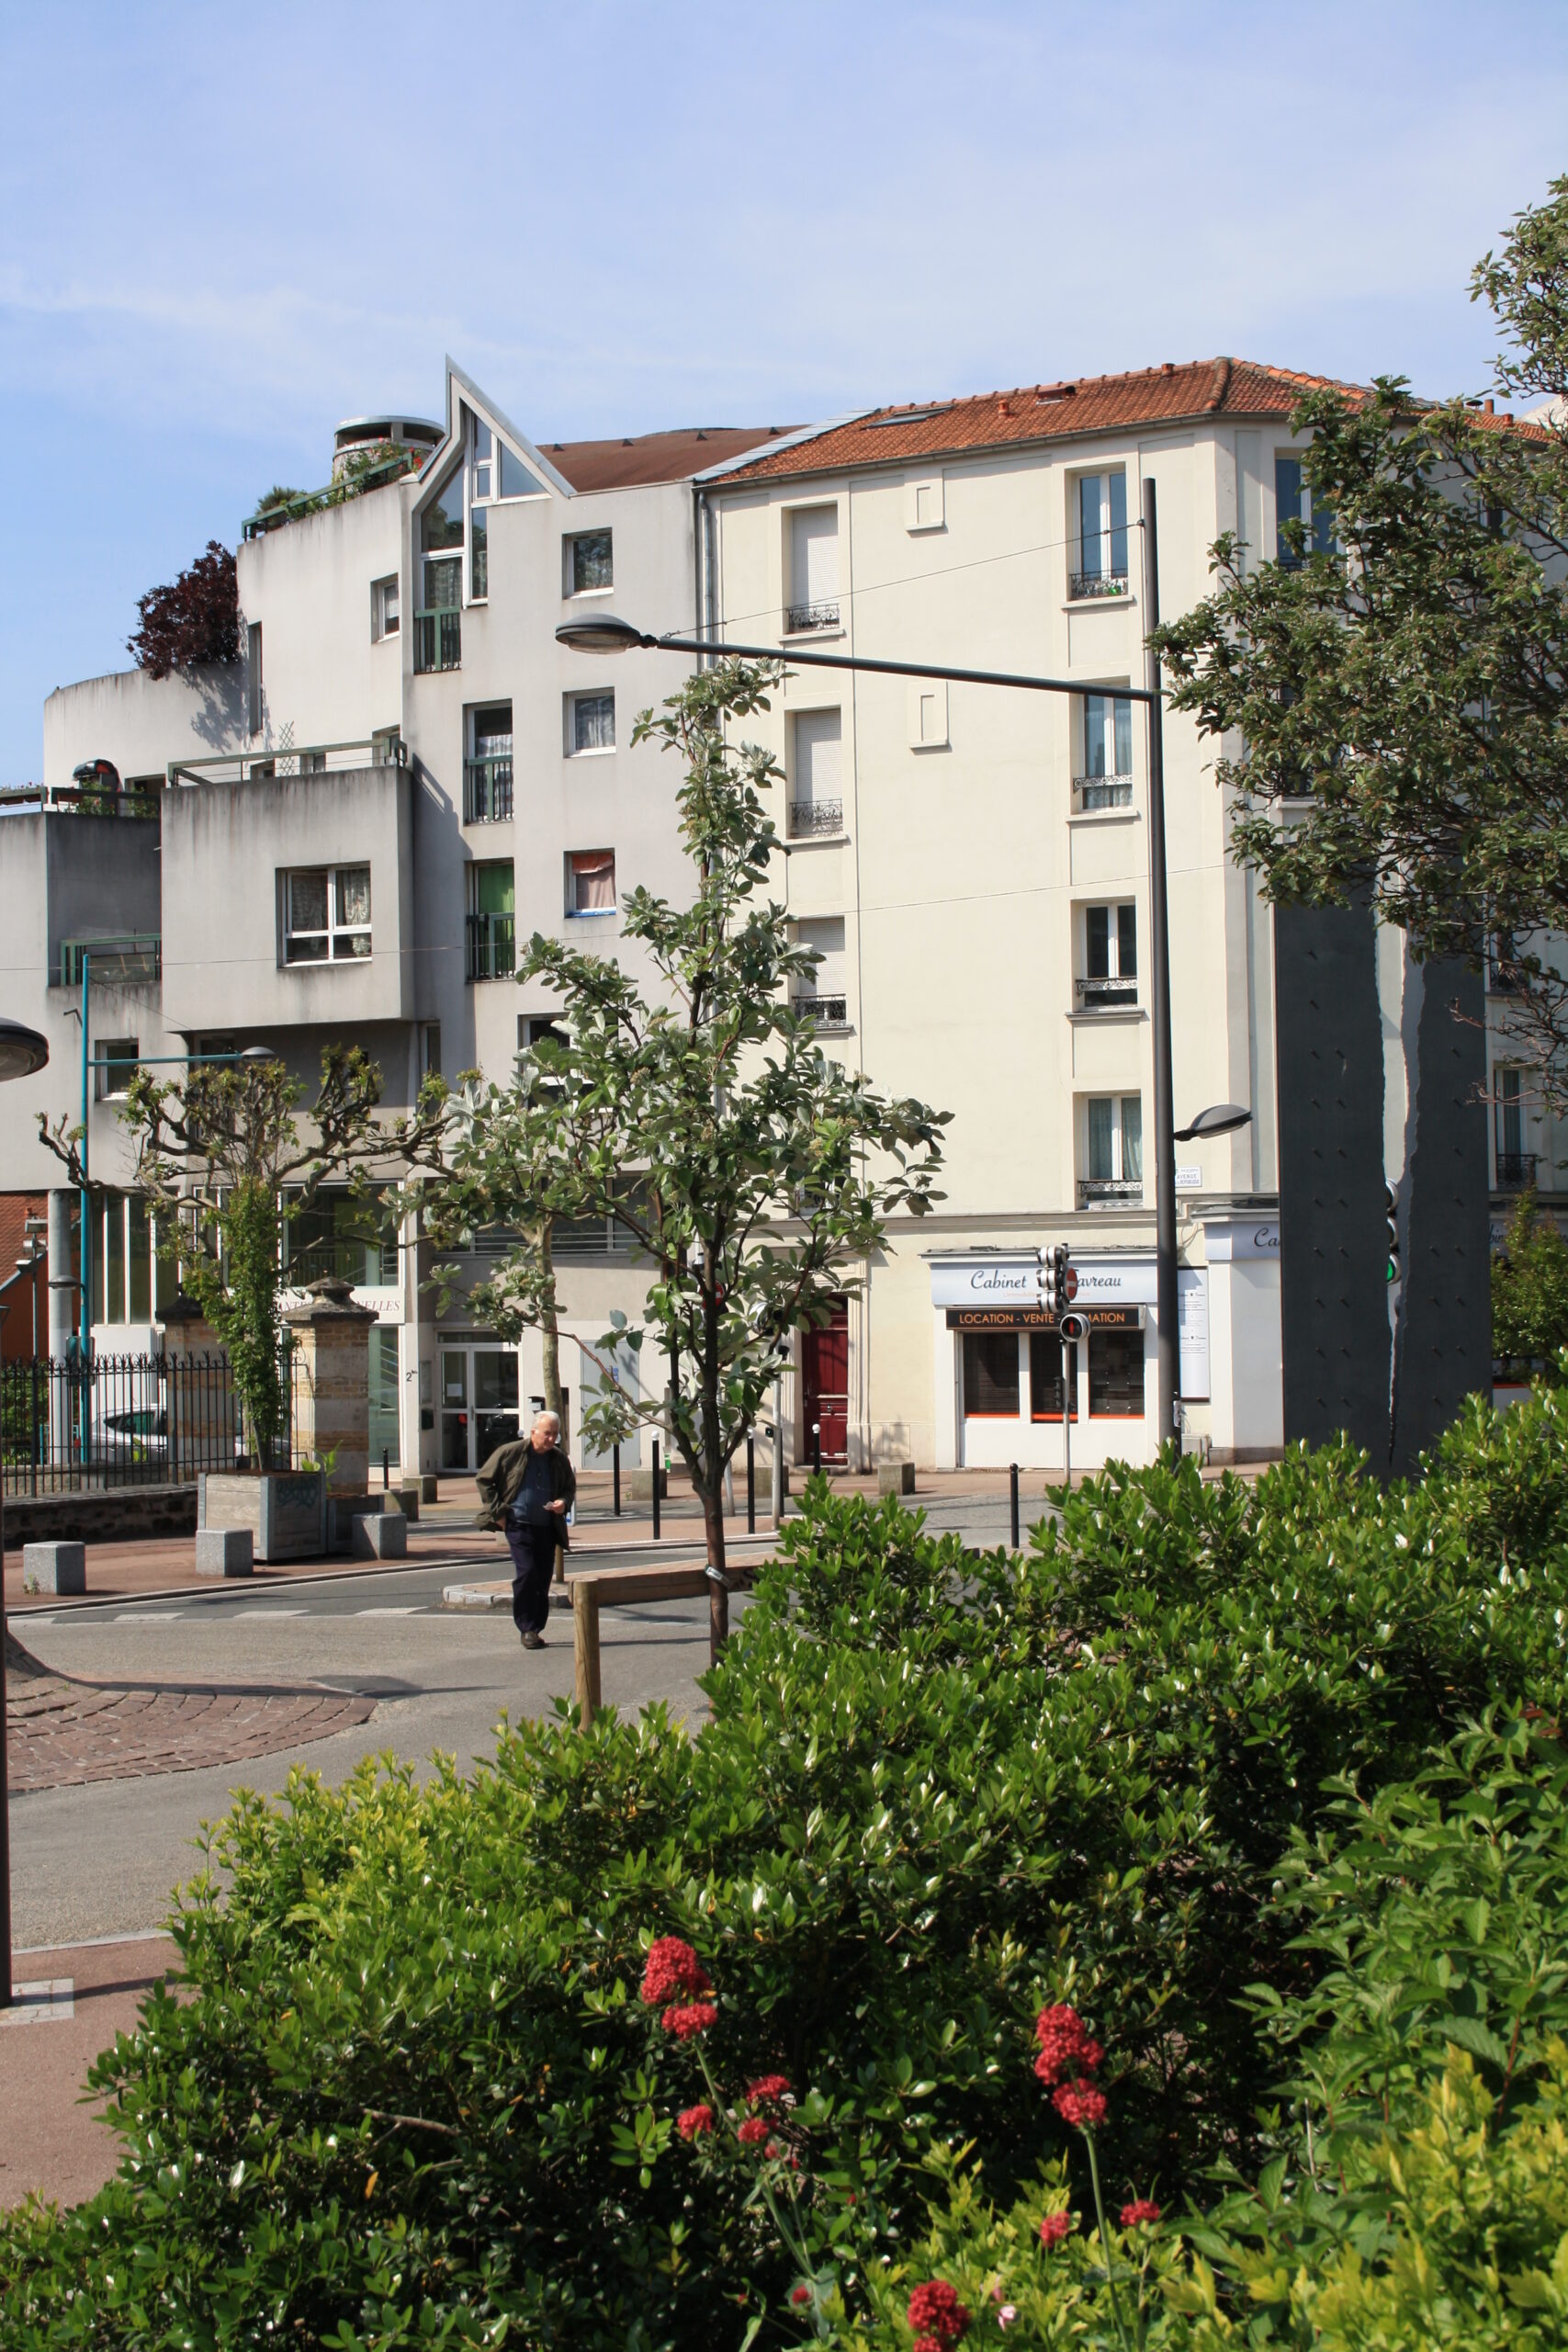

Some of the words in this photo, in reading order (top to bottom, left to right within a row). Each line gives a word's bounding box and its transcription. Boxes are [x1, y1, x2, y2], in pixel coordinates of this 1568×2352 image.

[970, 1270, 1028, 1289] Cabinet
[1075, 1273, 1122, 1287] avreau
[959, 1313, 1014, 1324] LOCATION
[1022, 1313, 1055, 1324] VENTE
